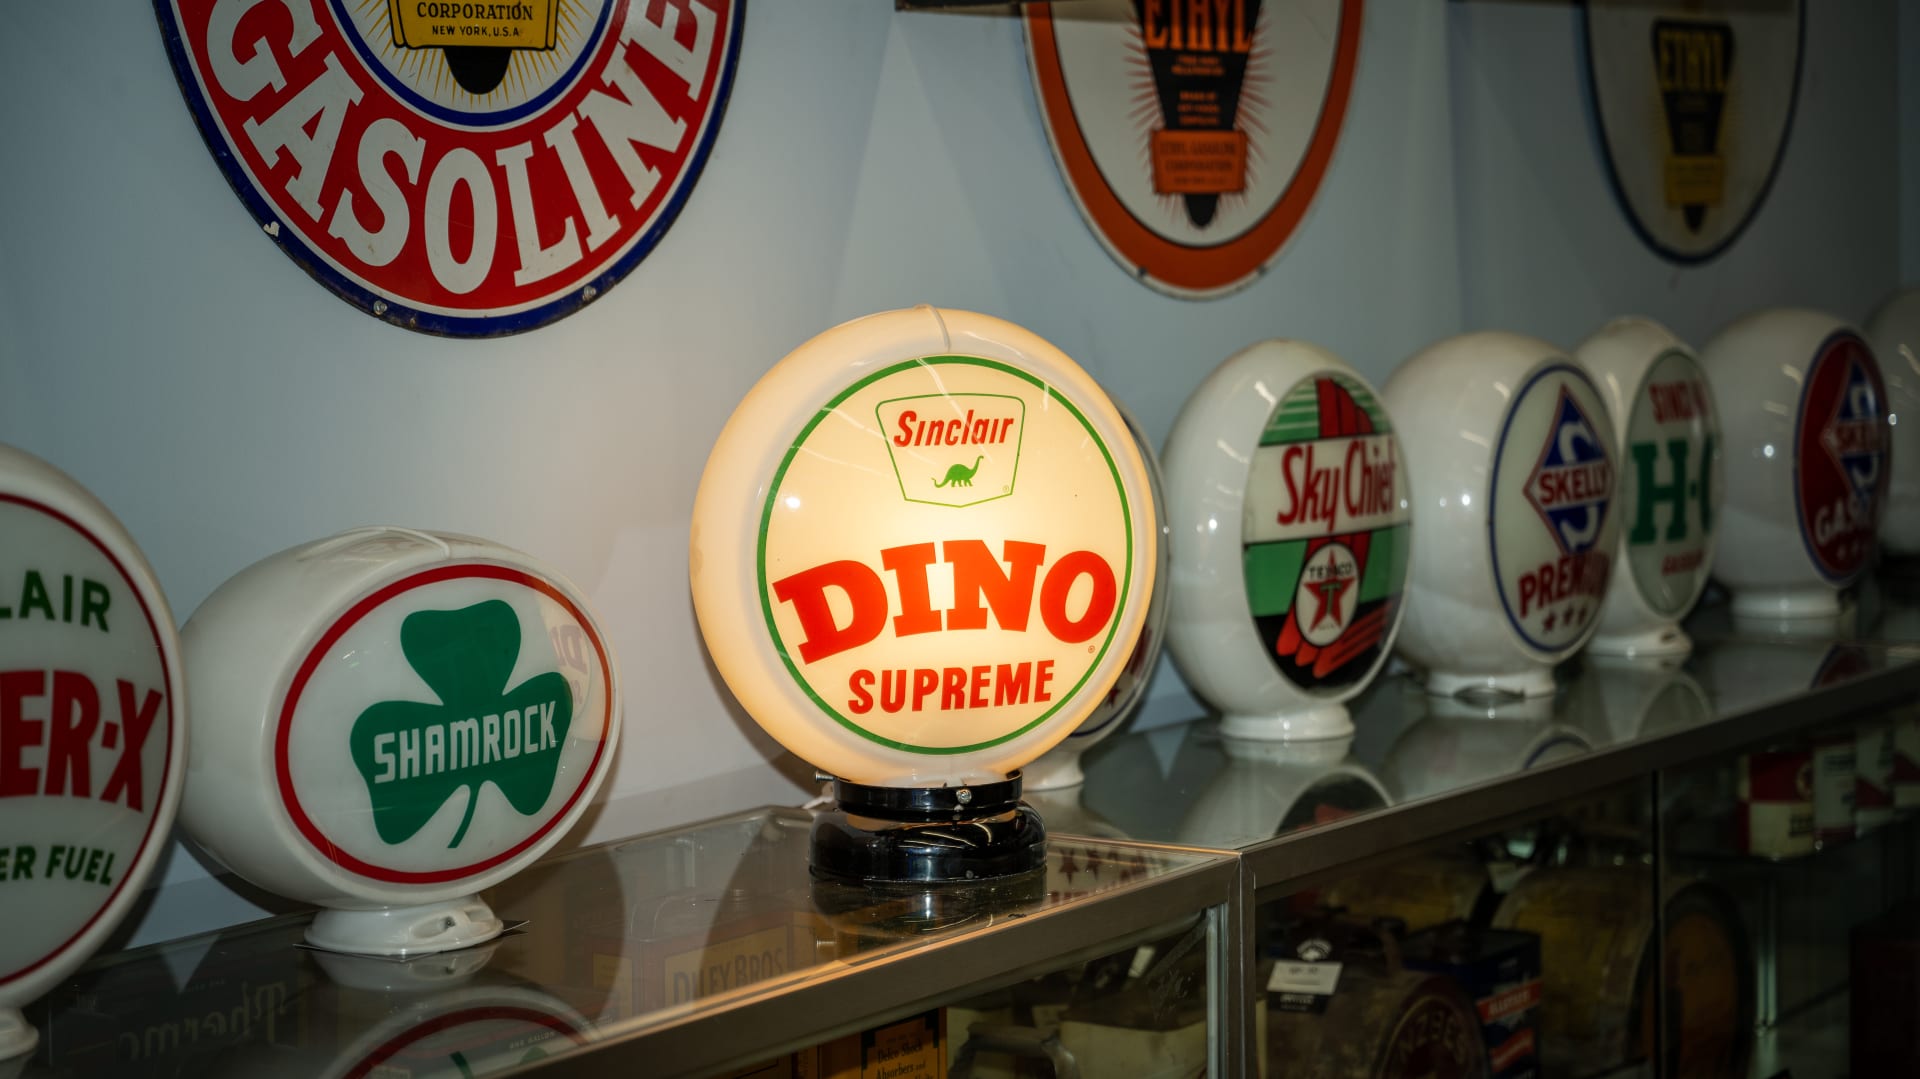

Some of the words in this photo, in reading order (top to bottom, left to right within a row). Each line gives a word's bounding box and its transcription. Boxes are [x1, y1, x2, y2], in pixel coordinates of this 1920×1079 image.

[416, 2, 534, 21] CORPORATION
[432, 25, 455, 36] NEW
[206, 0, 718, 295] GASOLINE
[893, 408, 1013, 447] Sinclair
[1277, 444, 1341, 533] Sky
[1309, 561, 1353, 580] TEXACO
[772, 538, 1117, 665] DINO
[847, 658, 1055, 715] SUPREME
[373, 700, 557, 784] SHAMROCK
[45, 845, 115, 887] FUEL
